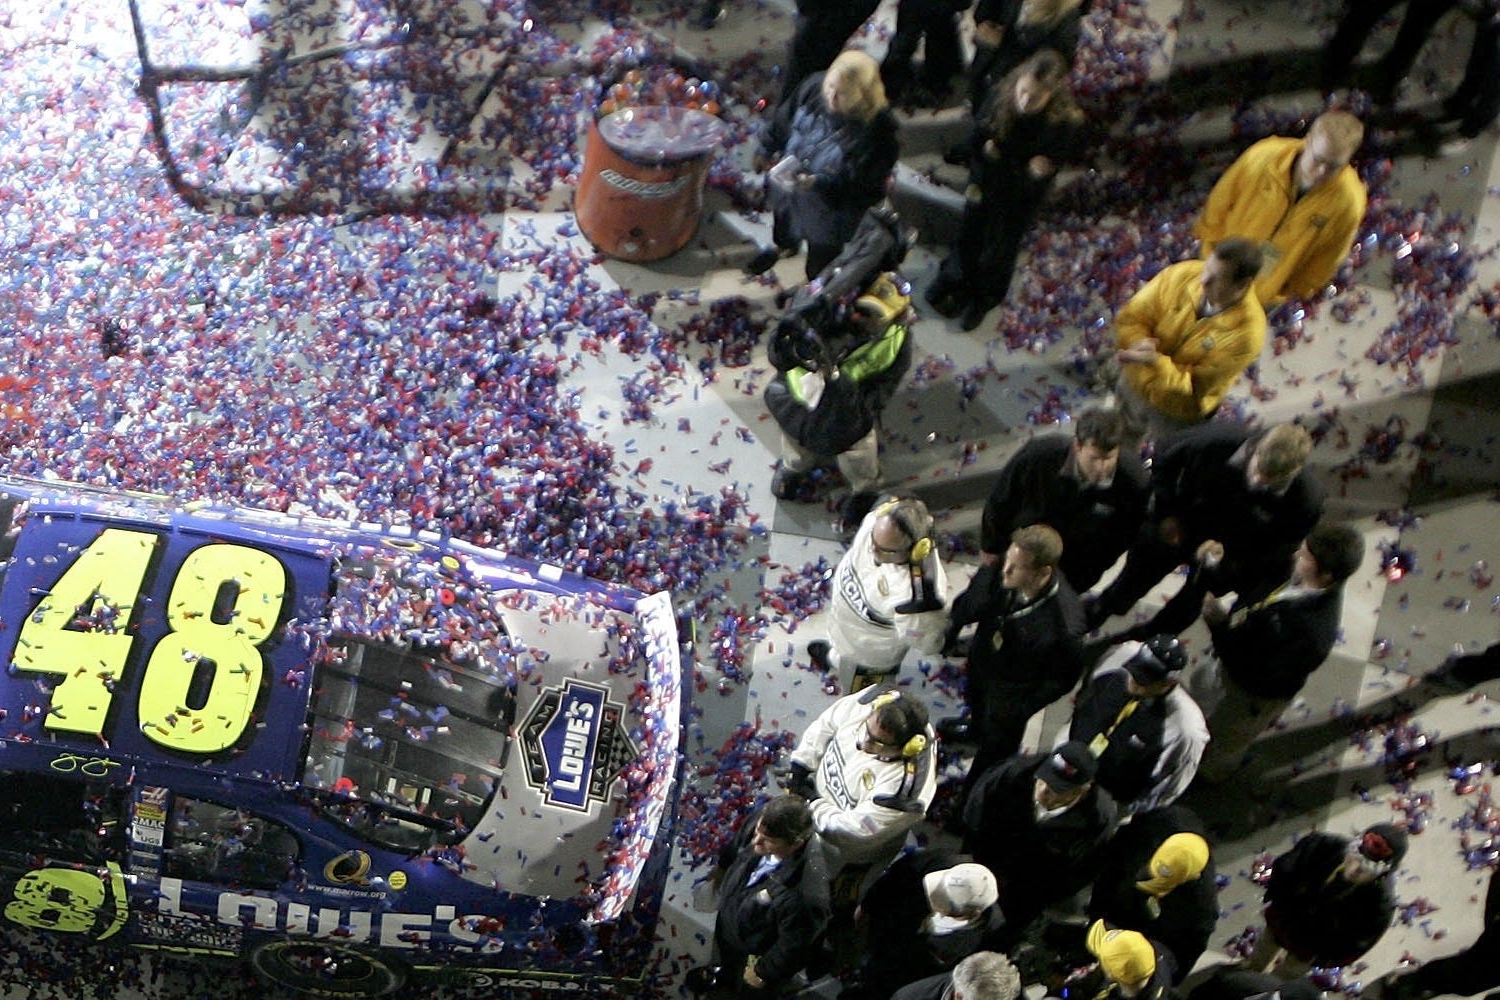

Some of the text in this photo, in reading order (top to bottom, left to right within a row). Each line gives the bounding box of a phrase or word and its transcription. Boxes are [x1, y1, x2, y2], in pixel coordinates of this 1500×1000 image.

[13, 527, 287, 753] 48
[527, 705, 554, 768] TEAM
[553, 700, 594, 792] LOWE'S
[158, 877, 505, 954] LOWE'S
[307, 883, 387, 899] www.marrow.org
